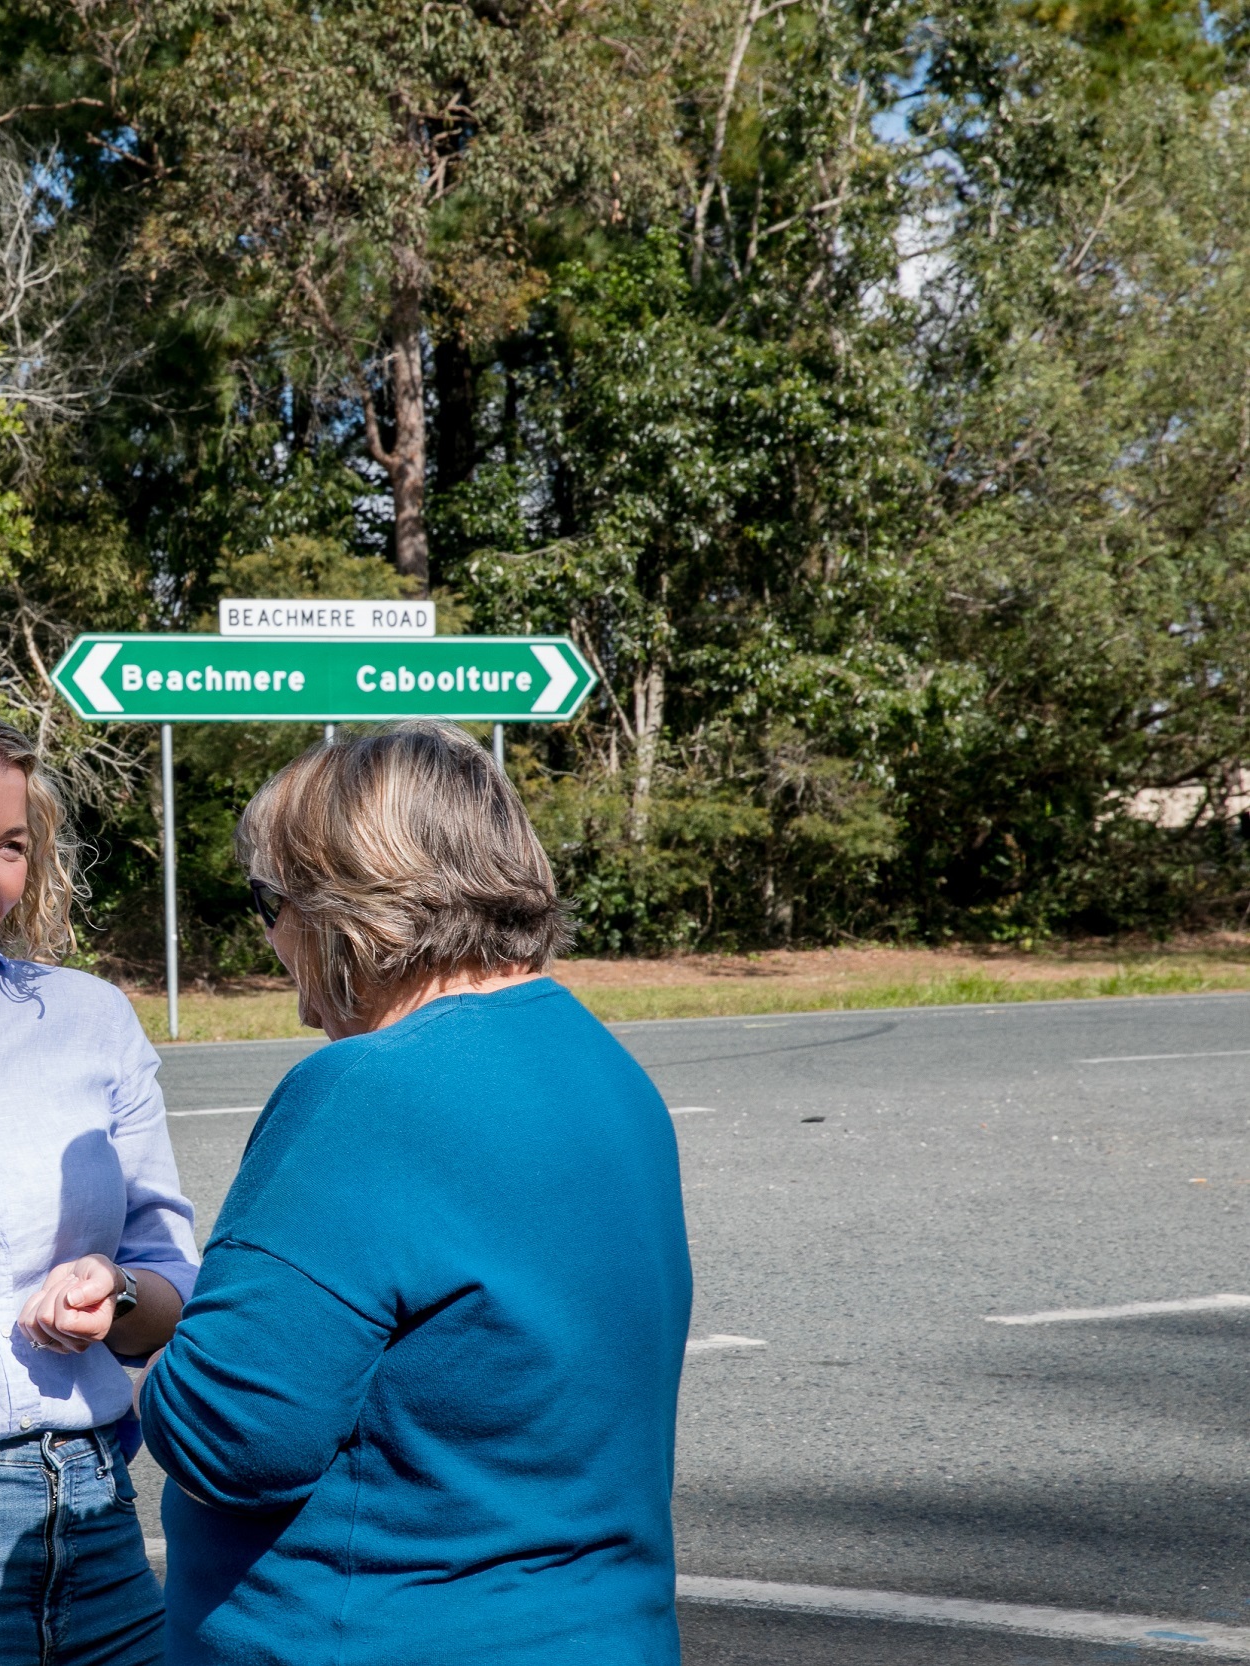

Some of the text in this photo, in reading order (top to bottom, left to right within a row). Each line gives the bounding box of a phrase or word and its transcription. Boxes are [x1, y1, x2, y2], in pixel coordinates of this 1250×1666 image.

[229, 609, 427, 627] BEACHMERE ROAD
[121, 664, 306, 692] Beachmere
[356, 664, 532, 693] Caboolture
